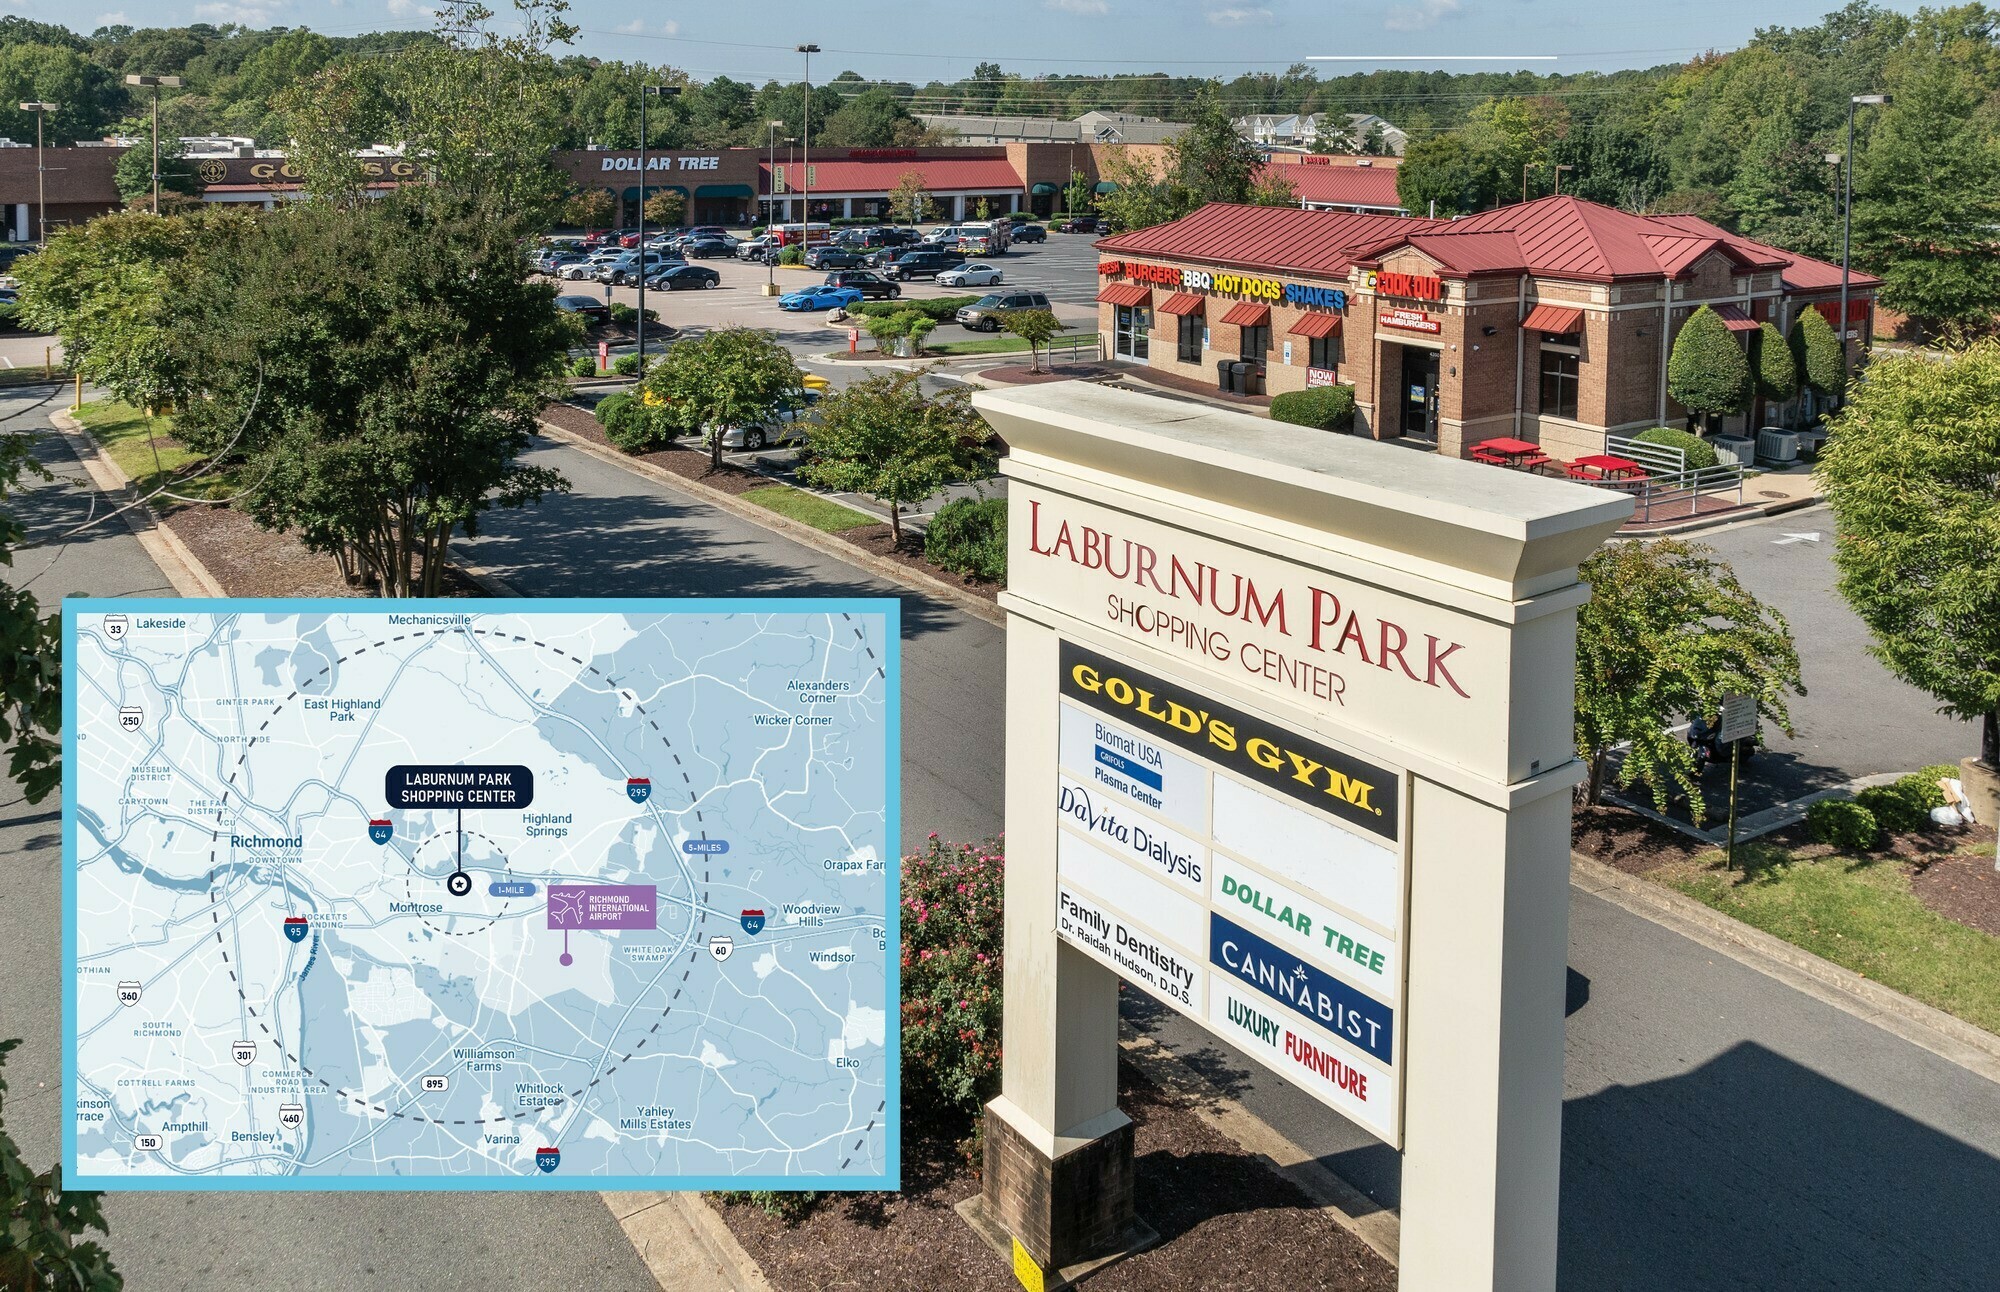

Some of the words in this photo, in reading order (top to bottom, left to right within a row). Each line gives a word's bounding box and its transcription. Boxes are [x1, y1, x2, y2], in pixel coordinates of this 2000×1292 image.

[601, 157, 671, 172] DOLLAR
[678, 156, 720, 170] TREE
[1097, 260, 1121, 276] FRESH
[1125, 263, 1181, 287] BURGERS
[1184, 271, 1210, 291] BBQ
[1285, 286, 1345, 310] SHAKES
[1377, 271, 1414, 297] COOK
[1414, 276, 1441, 300] OUT
[1394, 311, 1423, 321] FRESH
[1381, 316, 1437, 331] HAMBURGERS
[1310, 370, 1333, 380] NOW
[1029, 499, 1292, 637] LABURNUM
[1307, 585, 1471, 698] PARK
[1107, 594, 1230, 661] SHOPPING
[1240, 642, 1346, 706] CENTER
[1072, 664, 1238, 752] GOLD'S
[1095, 723, 1136, 756] Biomat
[1138, 743, 1163, 769] USA
[1100, 751, 1126, 770] GRIFOLS
[1095, 767, 1129, 795] Plasma
[1131, 785, 1163, 811] Center
[1058, 786, 1129, 844] DaVita
[1133, 826, 1202, 884] Dialysis
[1060, 892, 1111, 933] Family
[1116, 923, 1194, 989] Dentistry
[1221, 875, 1312, 937] DOLLAR
[1323, 926, 1386, 975] TREE
[1061, 917, 1075, 936] Dr.
[1077, 930, 1112, 957] Raidah
[1114, 950, 1157, 987] Hudson,
[1160, 979, 1193, 1007] D.D.S.
[1221, 940, 1381, 1049] CANNABIST
[1228, 996, 1280, 1048] LUXURY
[1285, 1031, 1367, 1103] FURNITURE
